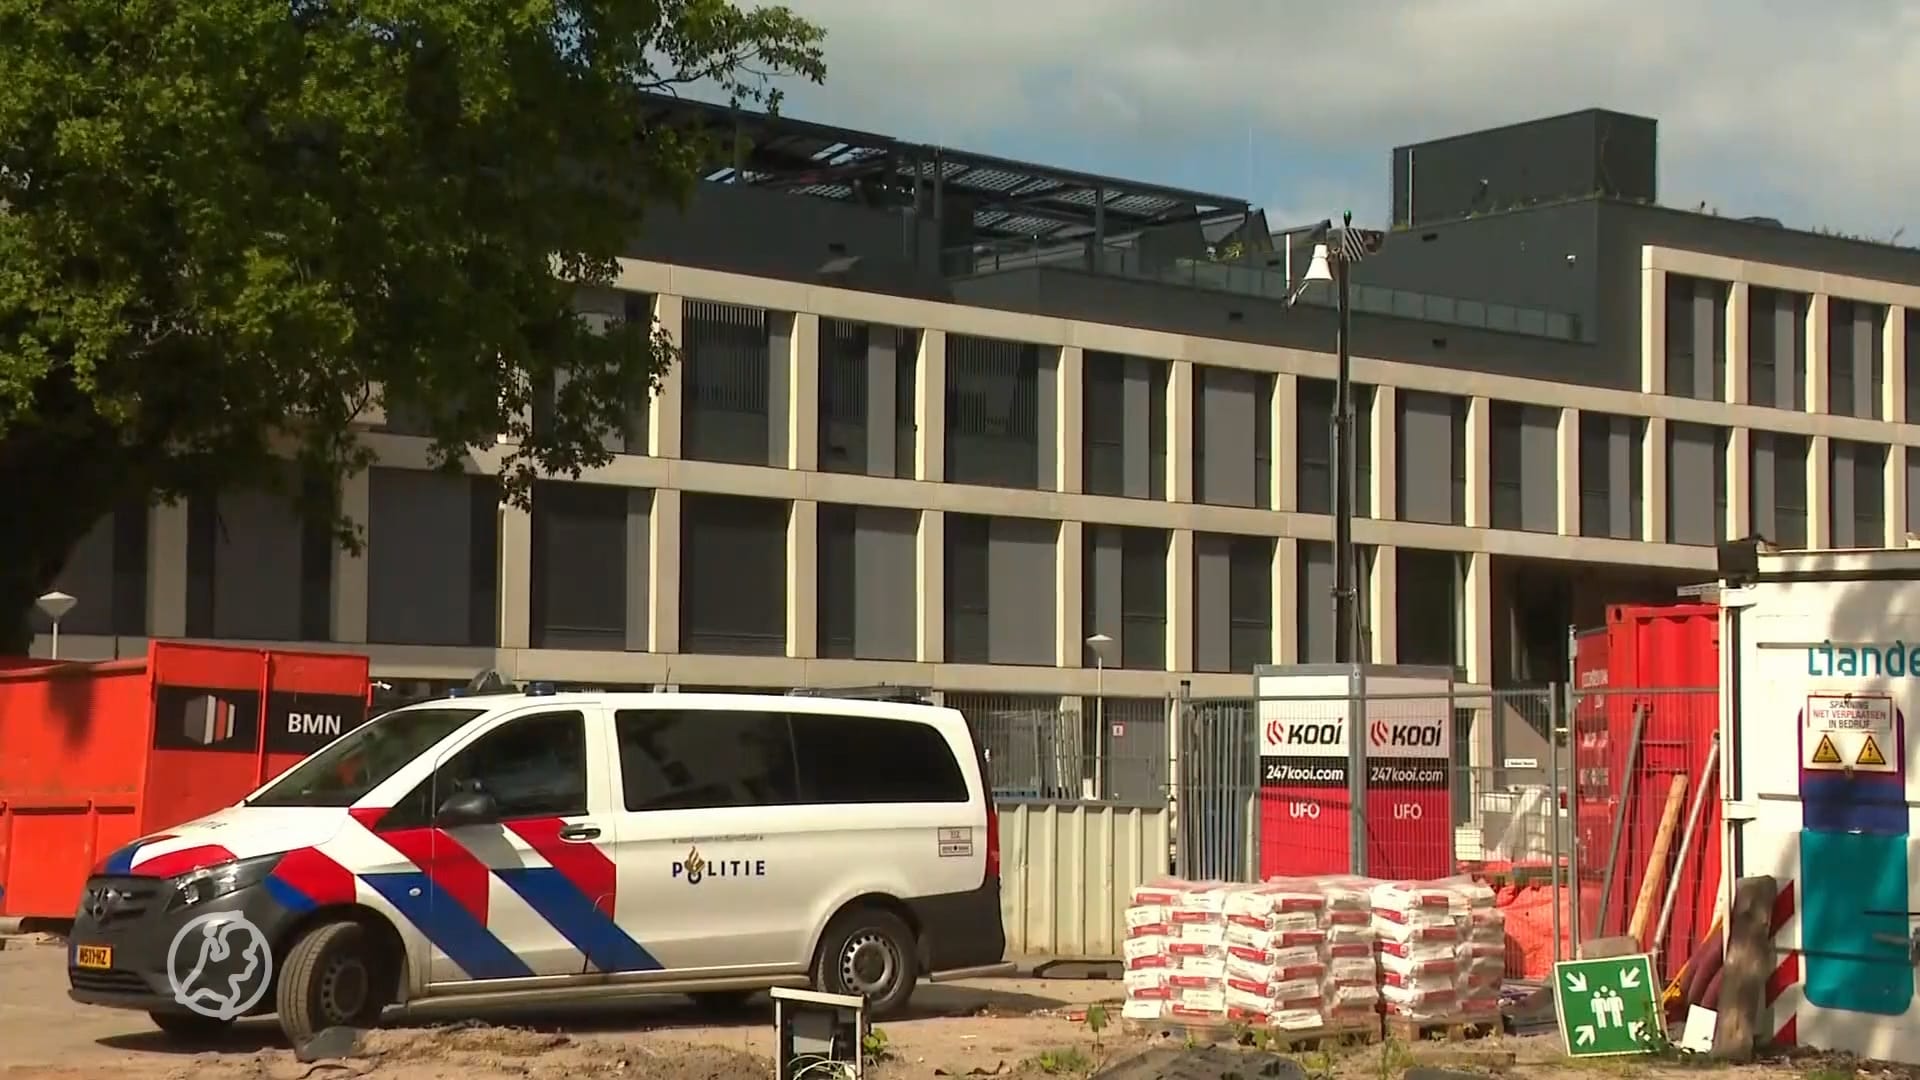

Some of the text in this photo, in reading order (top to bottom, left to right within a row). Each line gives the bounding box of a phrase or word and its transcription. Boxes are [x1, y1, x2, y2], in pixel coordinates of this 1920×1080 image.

[1813, 709, 1829, 718] NIET
[287, 712, 341, 735] BMN
[1828, 719, 1837, 728] IN
[1265, 764, 1344, 781] 247kooi.com
[1370, 766, 1443, 782] 247kooi.com
[1289, 801, 1321, 819] UFO
[1393, 803, 1422, 819] UFO
[672, 859, 766, 885] POLITIE
